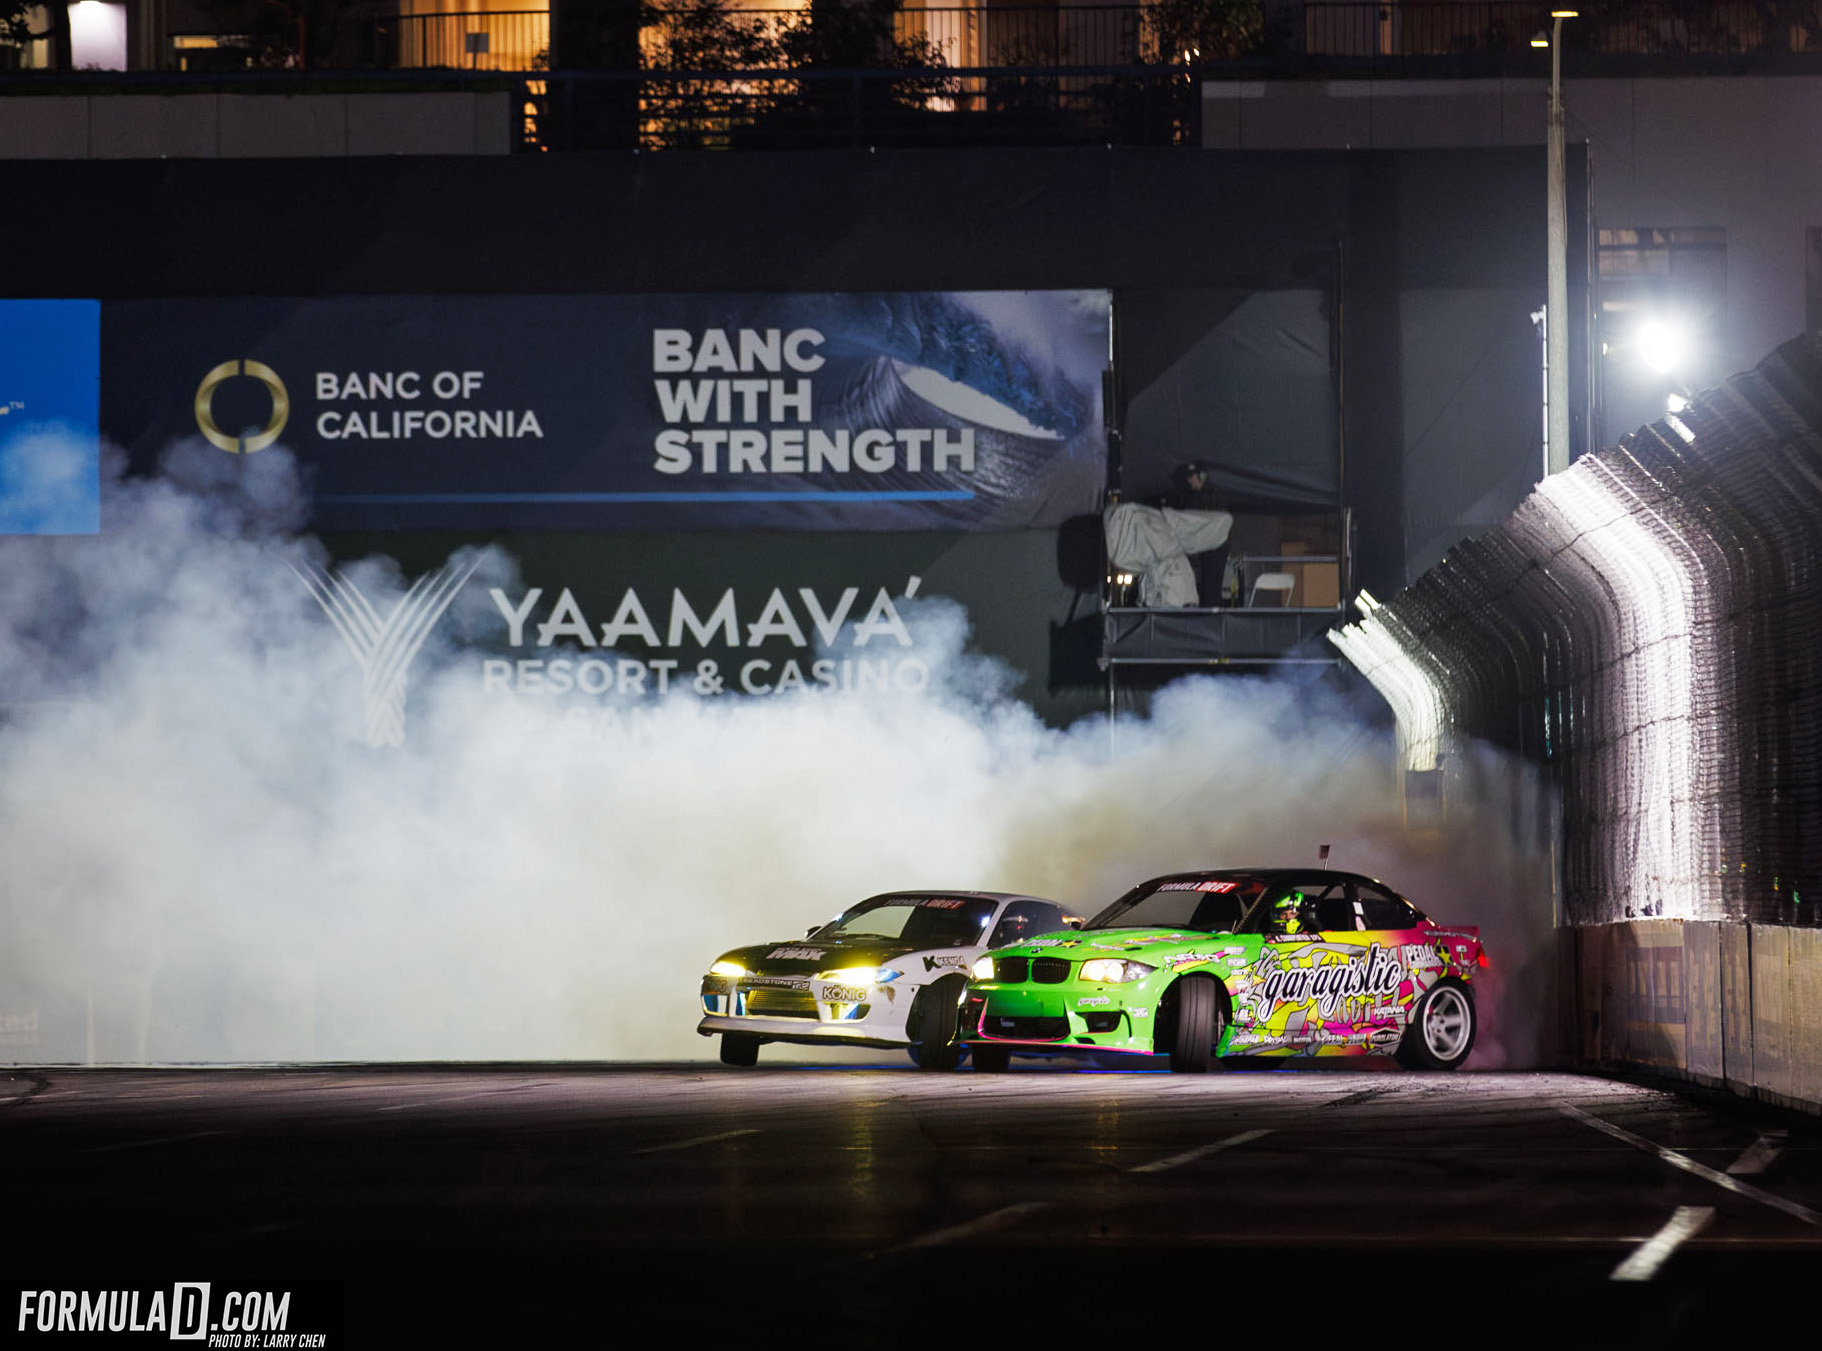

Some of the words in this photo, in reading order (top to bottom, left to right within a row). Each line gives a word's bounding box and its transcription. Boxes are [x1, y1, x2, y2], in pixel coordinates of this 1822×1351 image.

[654, 328, 827, 373] BANC
[316, 371, 422, 400] BANC
[432, 371, 485, 399] OF
[653, 379, 812, 423] WITH
[316, 409, 544, 439] CALIFORNIA
[653, 428, 976, 475] STRENGTH
[483, 659, 678, 696] RESORT
[696, 658, 724, 696] &
[740, 657, 930, 696] CASINO
[1155, 881, 1201, 893] FORMULA
[1197, 881, 1237, 894] DRIFT
[926, 898, 966, 909] DRIFT
[823, 984, 867, 1002] KÖNIG
[1257, 942, 1402, 1023] garagistic
[1374, 1005, 1406, 1019] KATANA
